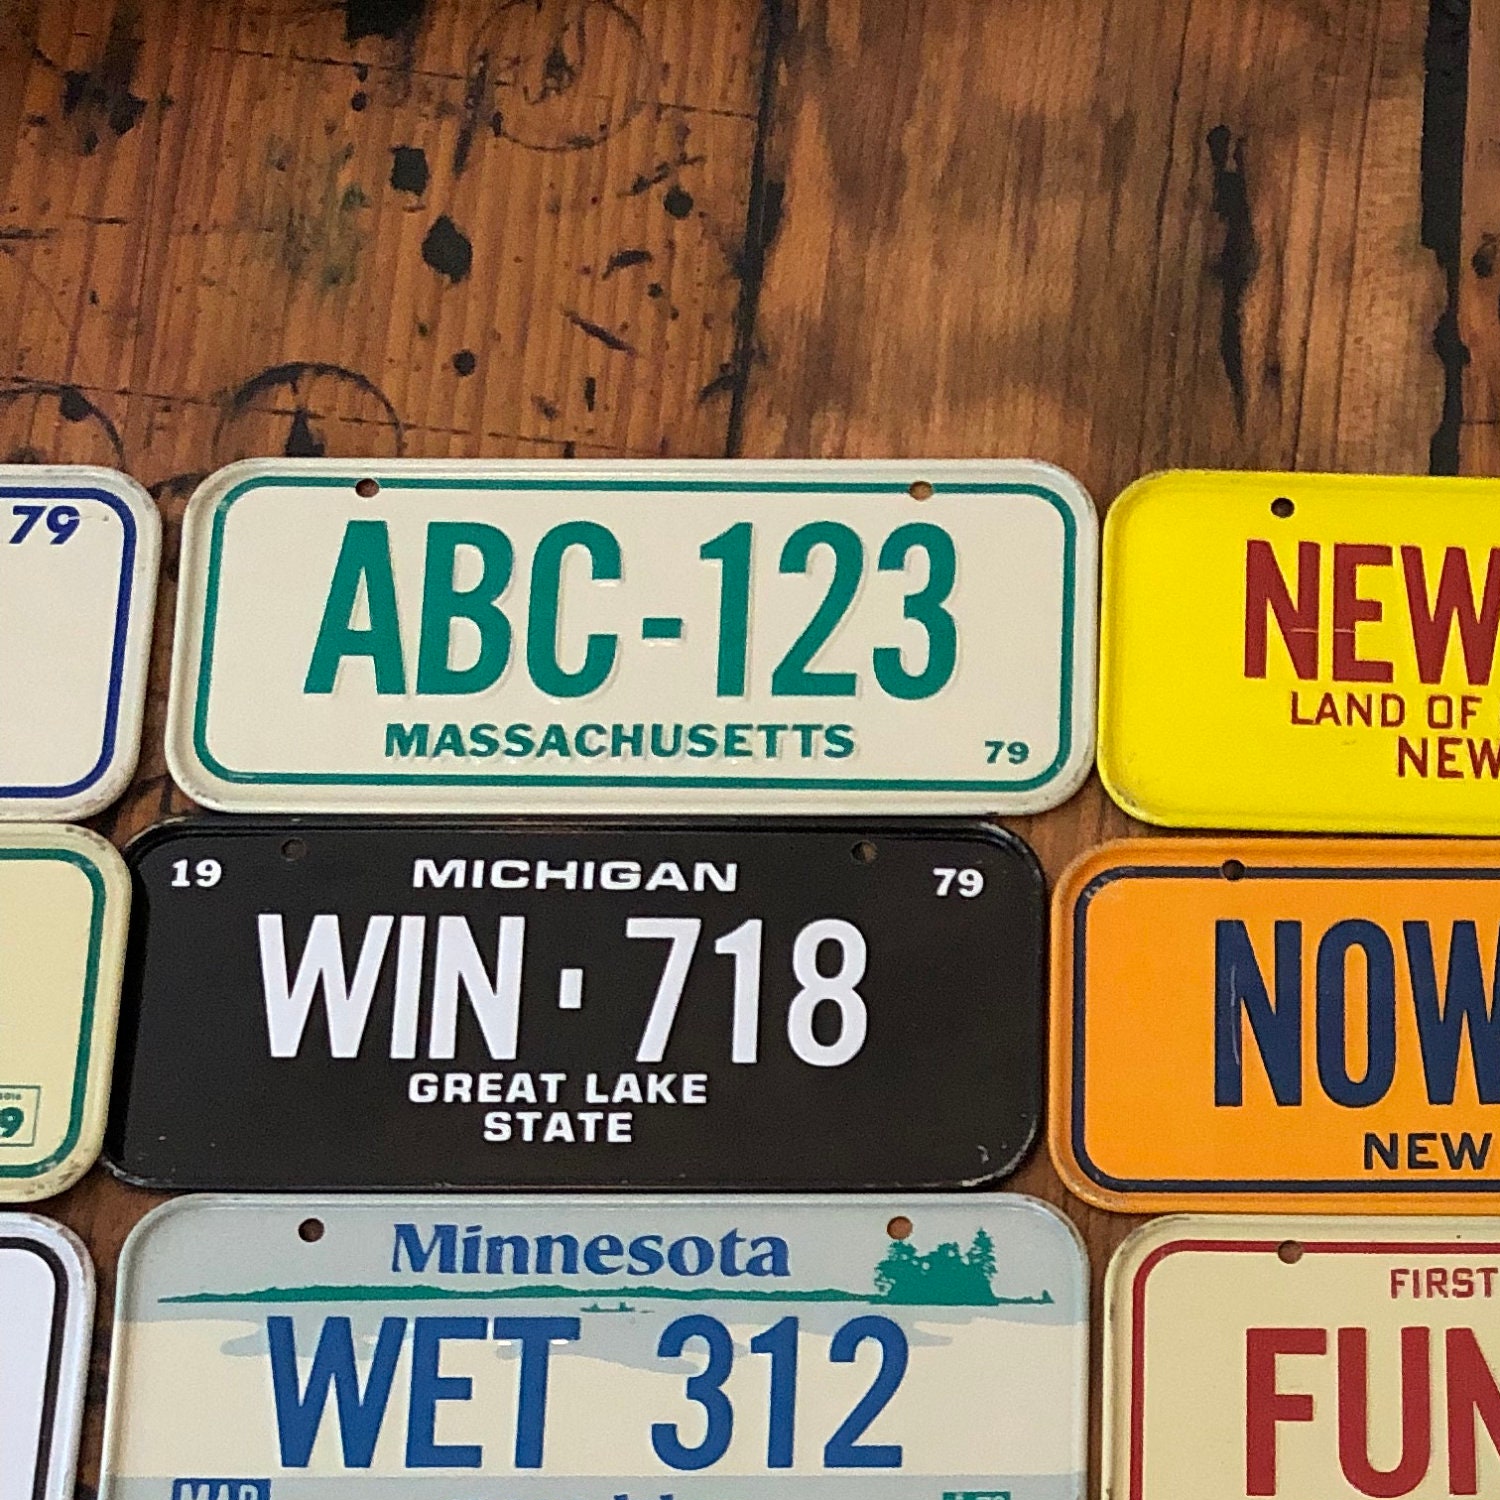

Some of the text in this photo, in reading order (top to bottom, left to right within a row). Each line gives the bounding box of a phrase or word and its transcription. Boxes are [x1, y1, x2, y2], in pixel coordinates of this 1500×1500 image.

[9, 506, 79, 544] 79
[304, 520, 956, 700] ABC-123
[1291, 691, 1405, 727] LAND
[1428, 695, 1482, 729] OF
[385, 723, 854, 758] MASSACHUSETTS
[985, 741, 1029, 764] 79
[172, 860, 221, 887] 19
[413, 860, 737, 891] MICHIGAN
[933, 868, 983, 897] 79
[409, 1073, 707, 1103] GREAT LAKE
[484, 1112, 632, 1142] STATE
[1364, 1132, 1492, 1170] NEW
[392, 1224, 790, 1277] Minnesota
[1391, 1268, 1498, 1298] FIRST
[267, 1314, 908, 1470] WET 312
